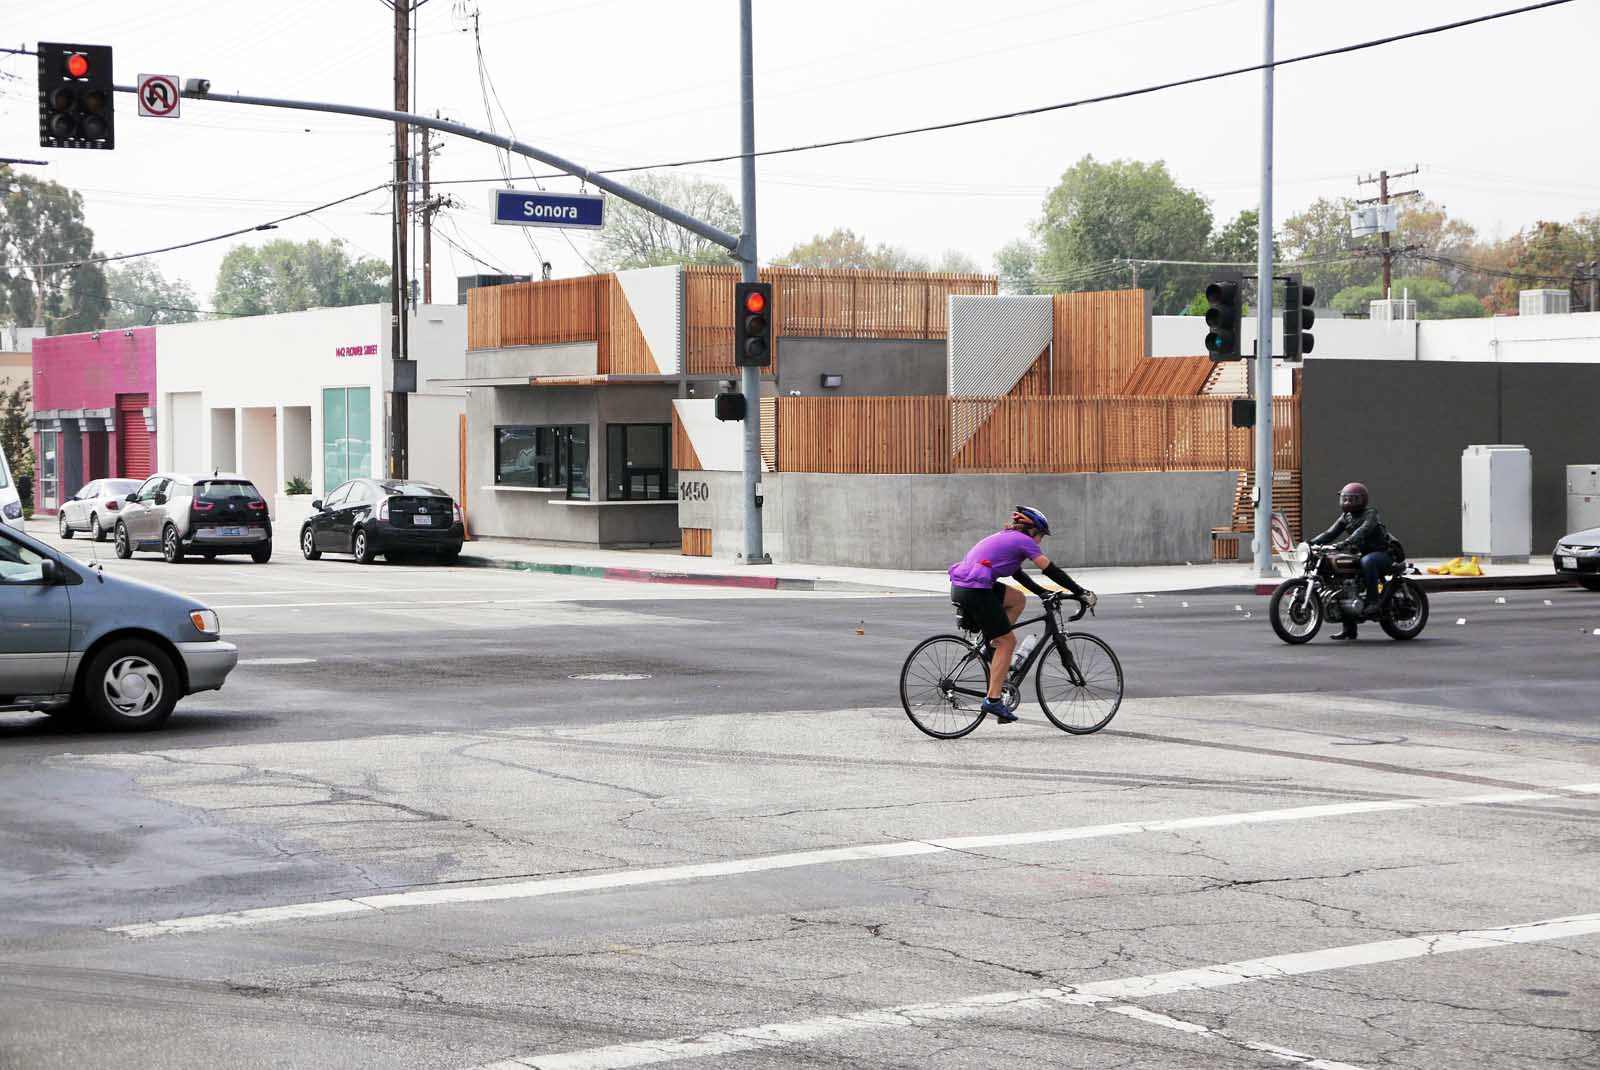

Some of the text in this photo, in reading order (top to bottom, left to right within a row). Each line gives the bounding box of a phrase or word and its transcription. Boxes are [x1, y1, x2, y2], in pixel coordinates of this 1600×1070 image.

[523, 200, 578, 219] Sonora
[346, 345, 363, 356] FLOWER
[364, 344, 378, 355] STREET
[680, 481, 709, 501] 1450
